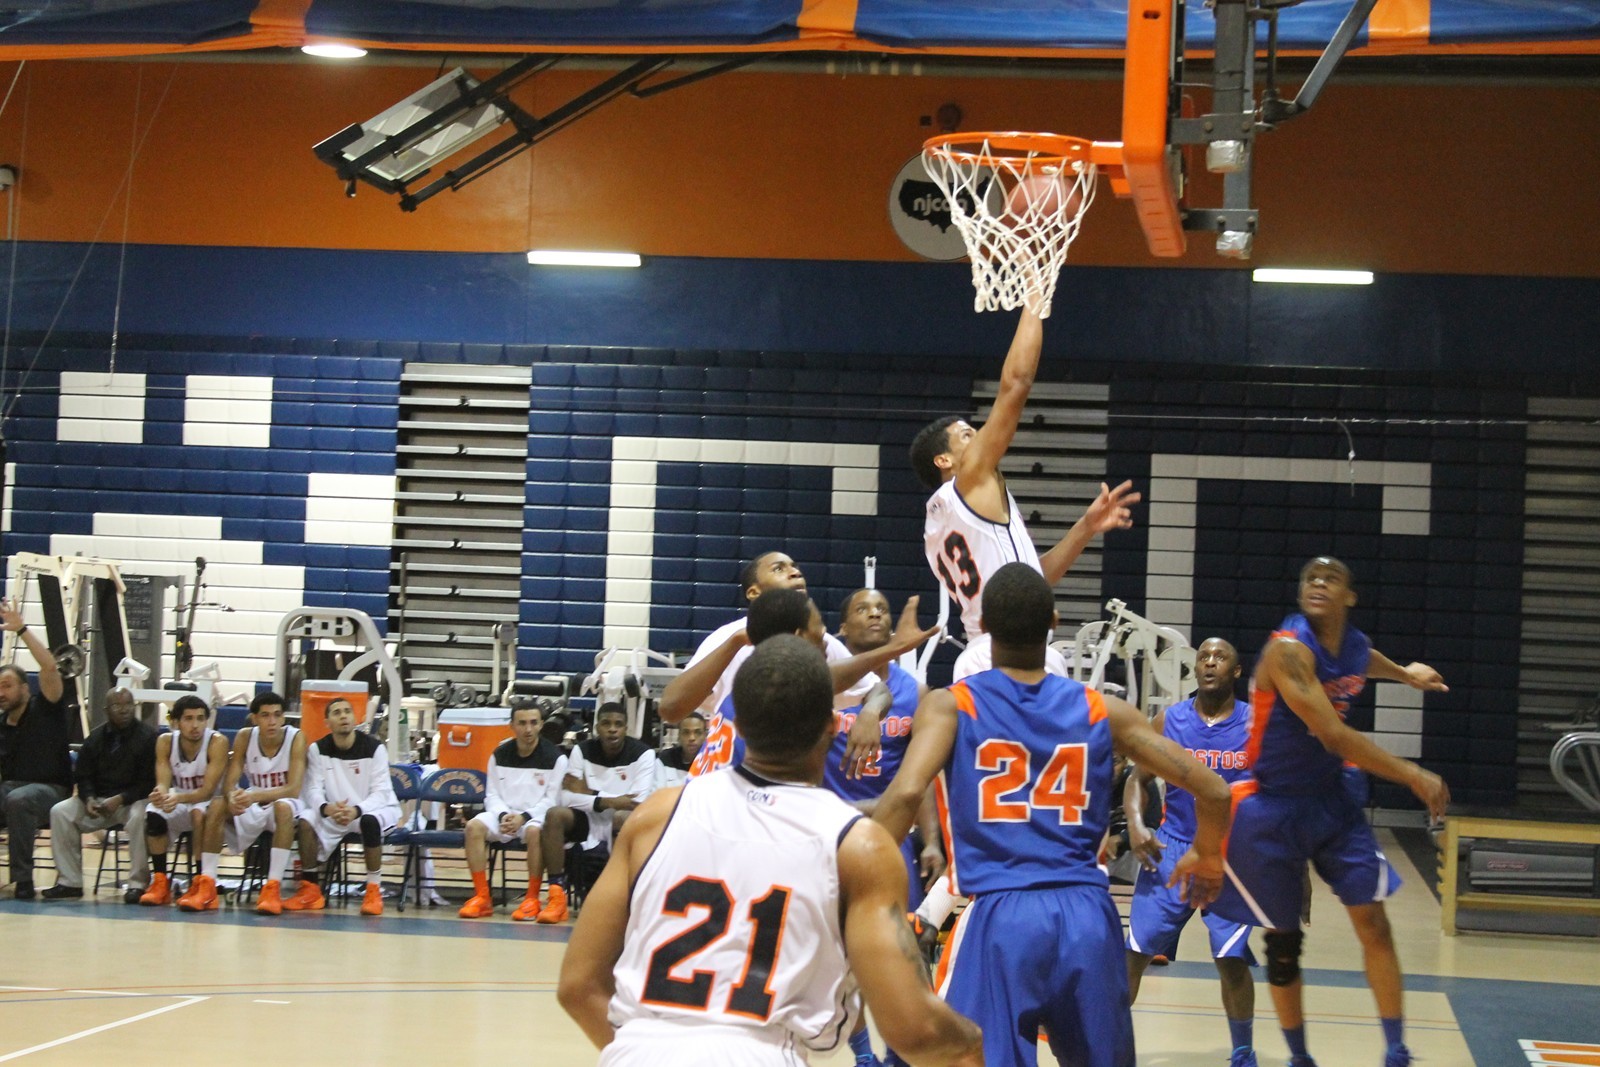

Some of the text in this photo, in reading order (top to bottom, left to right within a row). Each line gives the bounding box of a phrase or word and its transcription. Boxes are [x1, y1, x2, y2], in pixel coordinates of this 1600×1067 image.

[937, 530, 981, 604] 13
[975, 738, 1091, 825] 24
[641, 875, 792, 1022] 21
